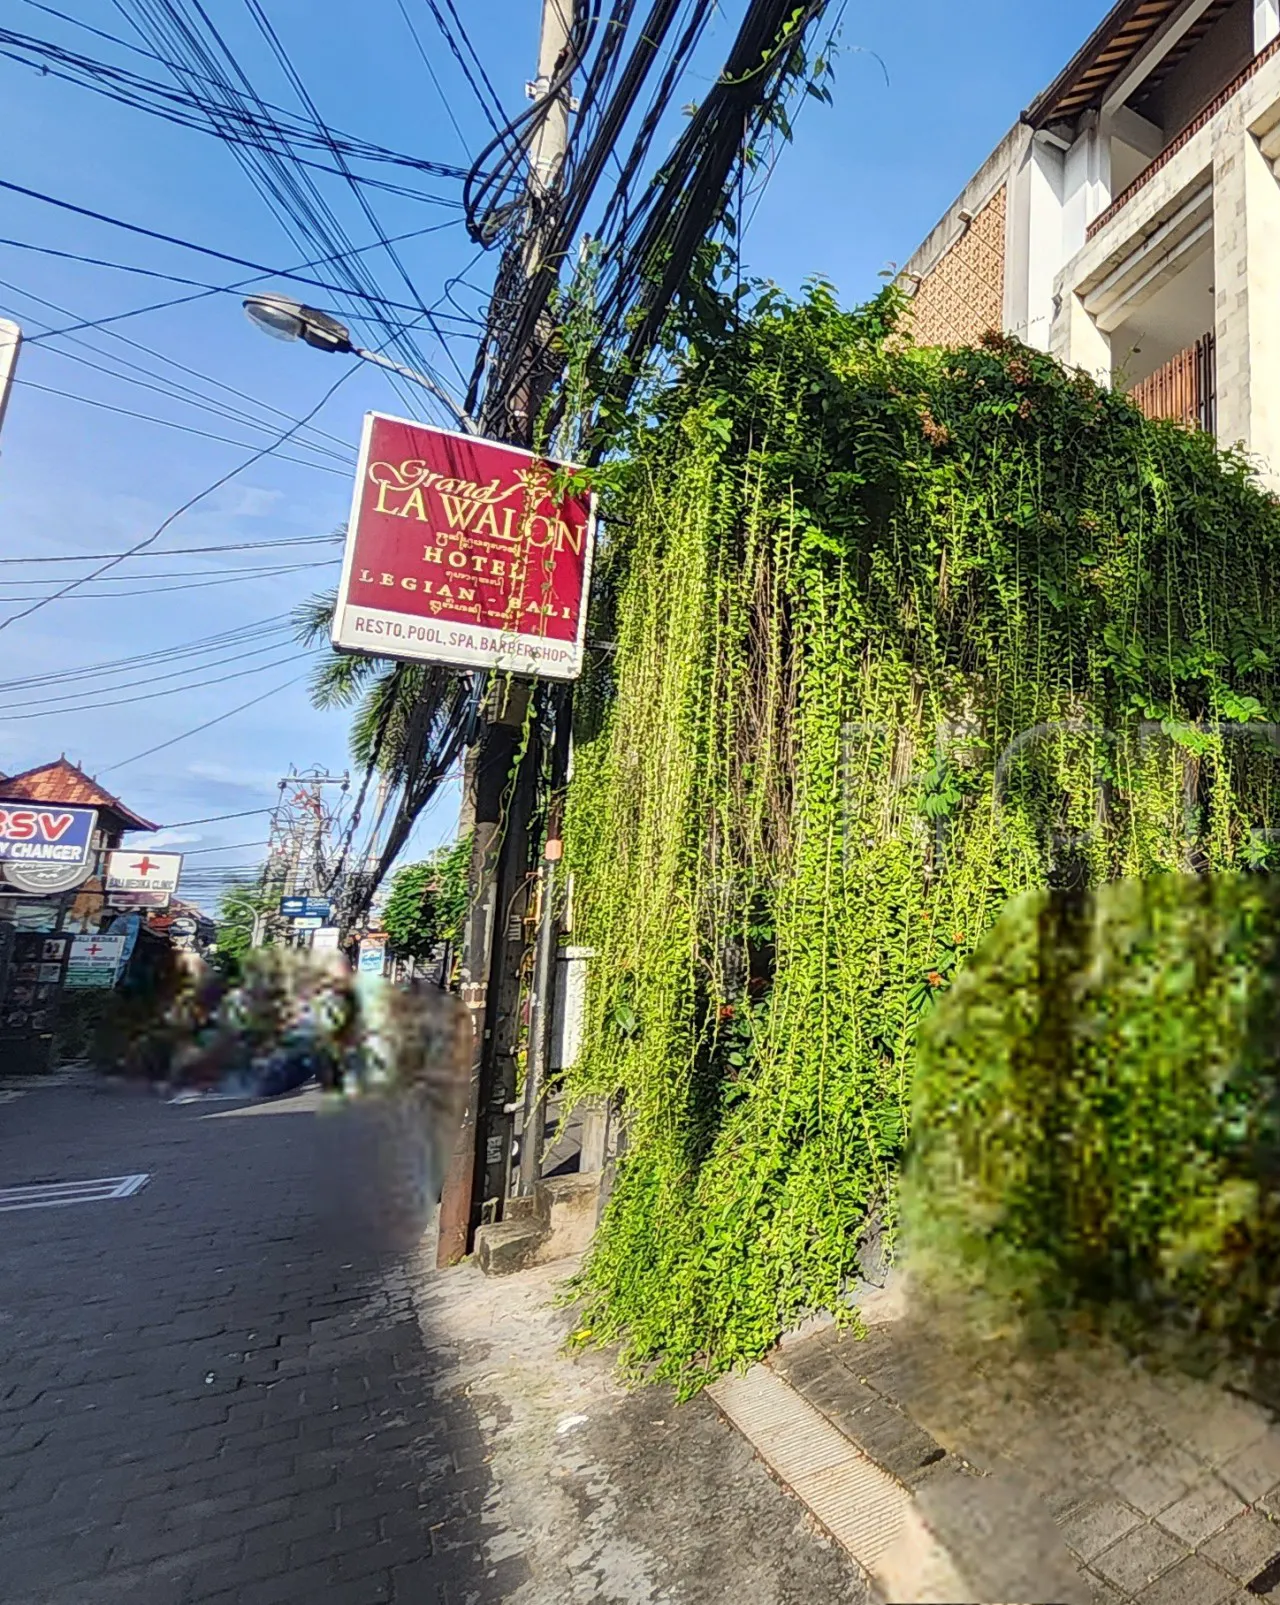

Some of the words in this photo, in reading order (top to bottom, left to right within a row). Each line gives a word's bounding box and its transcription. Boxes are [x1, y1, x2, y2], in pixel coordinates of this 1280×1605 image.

[369, 460, 522, 504] Grand
[372, 479, 428, 522] LA
[439, 493, 588, 555] WALON
[422, 545, 525, 582] HOTEL
[359, 568, 476, 602] LEGIAN
[508, 597, 571, 620] BALI
[11, 843, 82, 861] CHANGER
